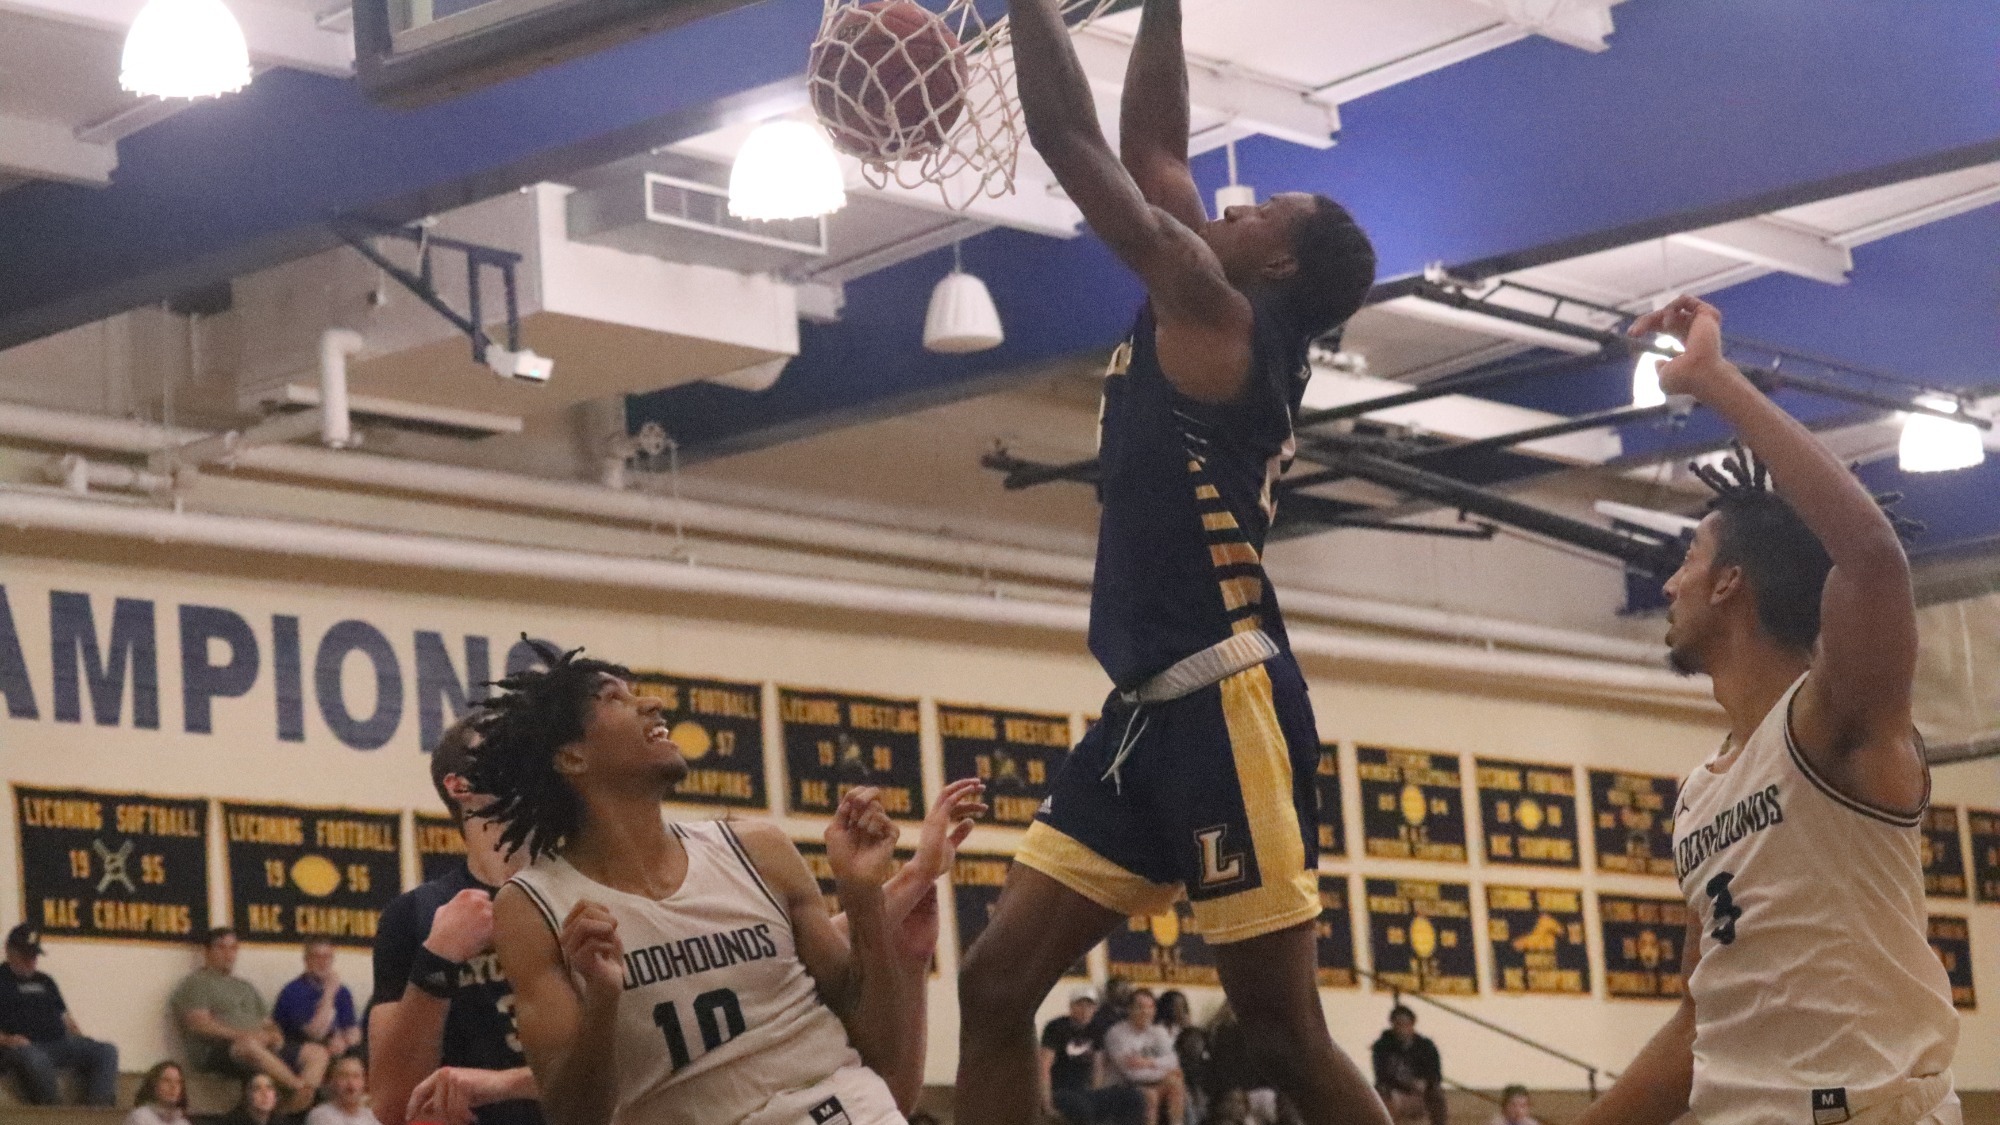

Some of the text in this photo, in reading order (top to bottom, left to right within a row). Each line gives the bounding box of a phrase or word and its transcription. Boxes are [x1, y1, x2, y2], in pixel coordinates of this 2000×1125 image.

[0, 583, 566, 755] MPION
[23, 797, 199, 837] LYCOMING SOFTBALL
[227, 813, 398, 851] LYCOMING FOOTBALL
[1196, 826, 1243, 887] L
[93, 901, 192, 934] CHAMPIONS
[623, 923, 777, 991] OODHOUNDS
[652, 987, 746, 1075] 10
[819, 1103, 834, 1118] M
[1821, 1093, 1835, 1106] M
